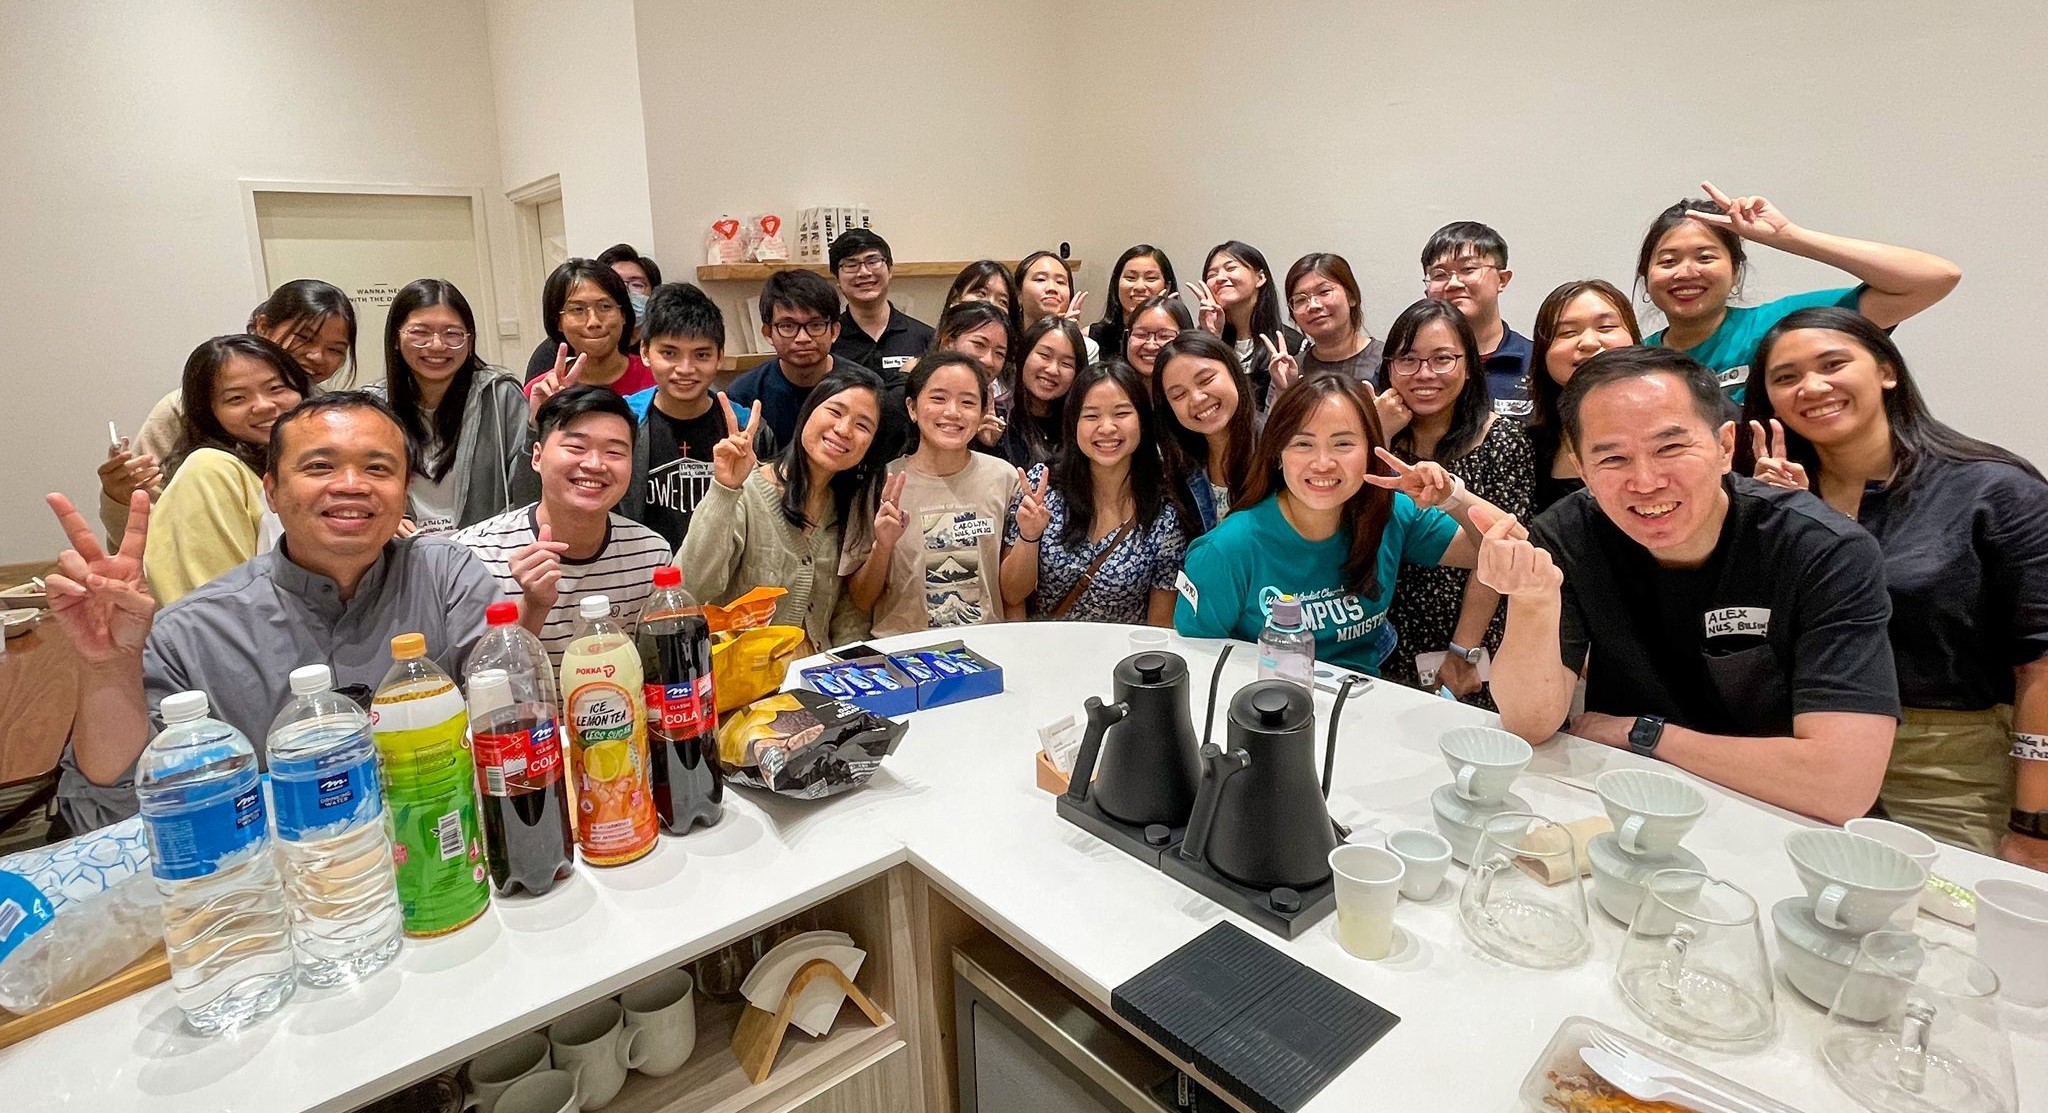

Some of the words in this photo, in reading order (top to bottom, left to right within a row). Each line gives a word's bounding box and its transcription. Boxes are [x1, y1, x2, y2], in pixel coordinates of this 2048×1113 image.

[953, 520, 988, 532] CAROLYN
[1300, 595, 1365, 631] MPUS
[1708, 609, 1748, 625] ALEX
[1708, 622, 1734, 634] NUS,
[576, 667, 602, 675] POKKA
[590, 701, 608, 714] ICE
[669, 701, 691, 711] CLASSIC
[576, 714, 609, 727] LEMON
[610, 710, 626, 724] TEA
[664, 711, 699, 725] COLA
[585, 730, 606, 741] LESS
[606, 724, 632, 740] SUGAR
[530, 750, 560, 772] COLA
